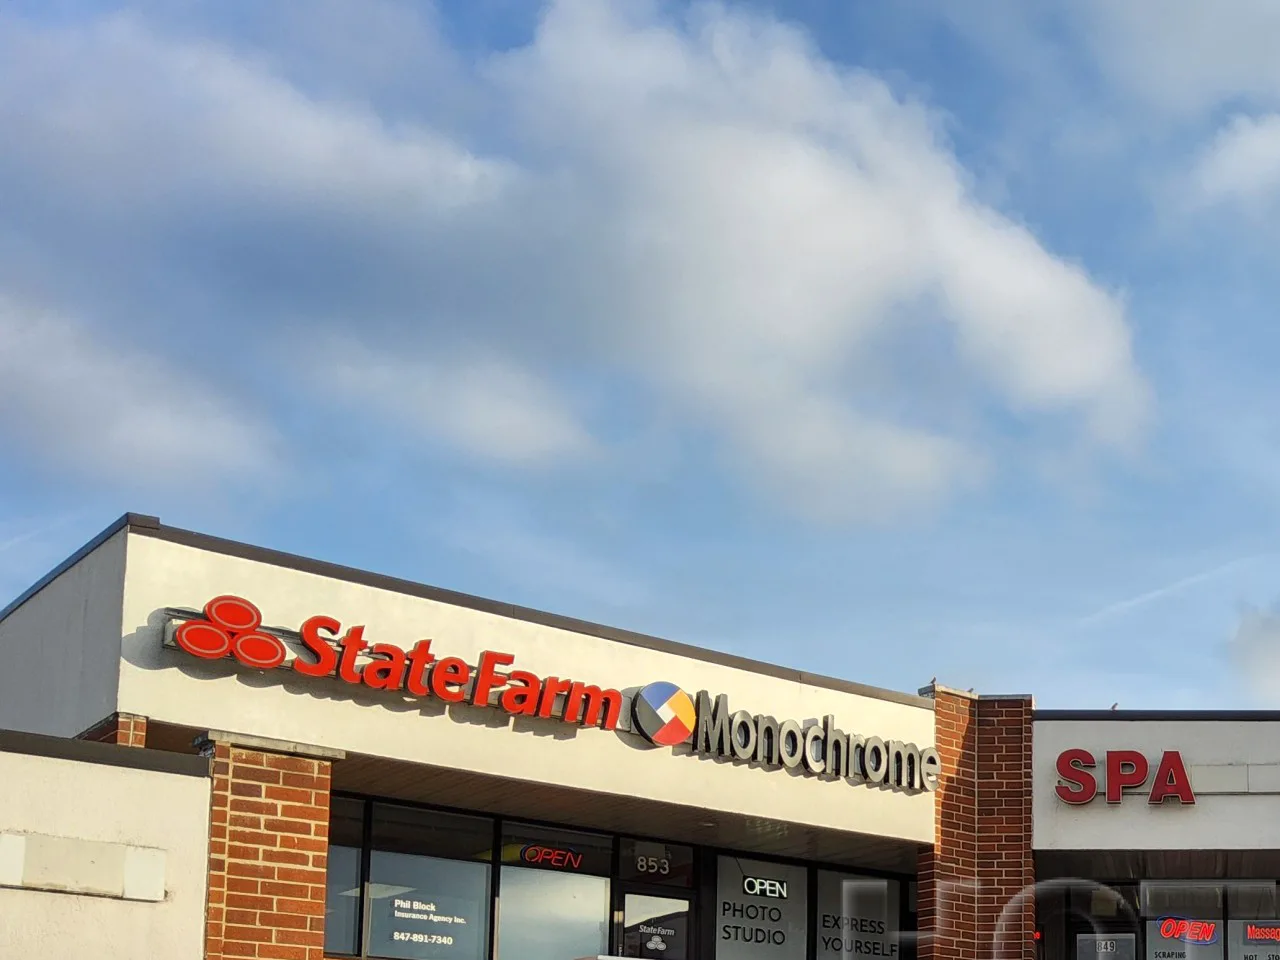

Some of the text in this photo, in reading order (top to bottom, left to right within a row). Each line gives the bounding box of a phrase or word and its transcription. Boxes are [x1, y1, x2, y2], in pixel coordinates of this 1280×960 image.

[692, 689, 941, 794] Monochrome
[1055, 748, 1196, 806] SPA
[524, 845, 583, 869] OPEN
[637, 855, 670, 875] 853
[743, 877, 787, 898] OPEN
[394, 898, 436, 912] Phil Block
[722, 901, 782, 922] PHOTO
[394, 910, 467, 924] Insurance Agency Inc.
[822, 913, 885, 935] EXPRESS
[393, 931, 453, 946] 847-891-7340
[722, 925, 786, 946] STUDIO
[1160, 918, 1216, 941] OPEN
[822, 936, 898, 957] YOURSELF
[1096, 941, 1115, 952] 849
[1154, 951, 1187, 959] SCRAPING
